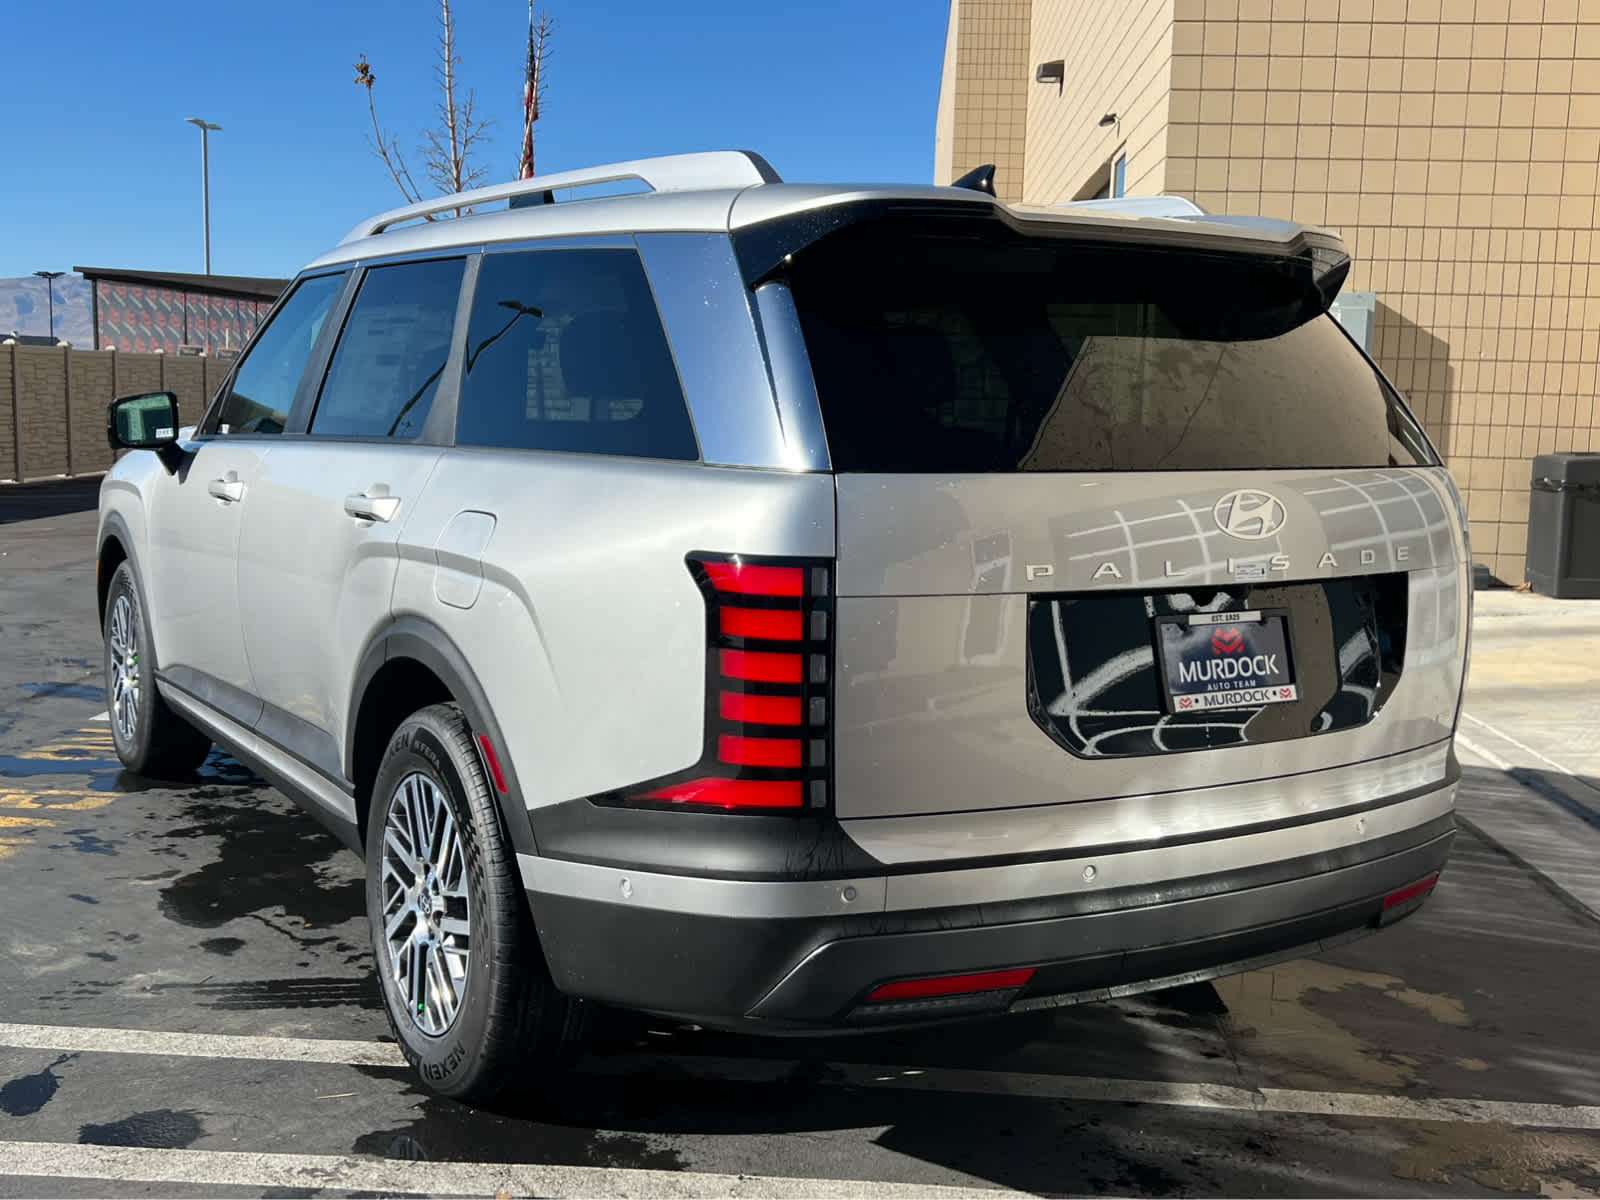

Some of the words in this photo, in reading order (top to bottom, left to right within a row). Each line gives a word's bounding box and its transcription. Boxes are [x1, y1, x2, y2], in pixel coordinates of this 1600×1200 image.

[1026, 545, 1410, 581] PALISADE
[1178, 654, 1279, 683] MURDOCK
[1204, 689, 1271, 707] MURDOCK
[1207, 682, 1231, 691] AUTO
[1234, 679, 1256, 688] TEAM
[423, 1039, 465, 1080] NEXEN
